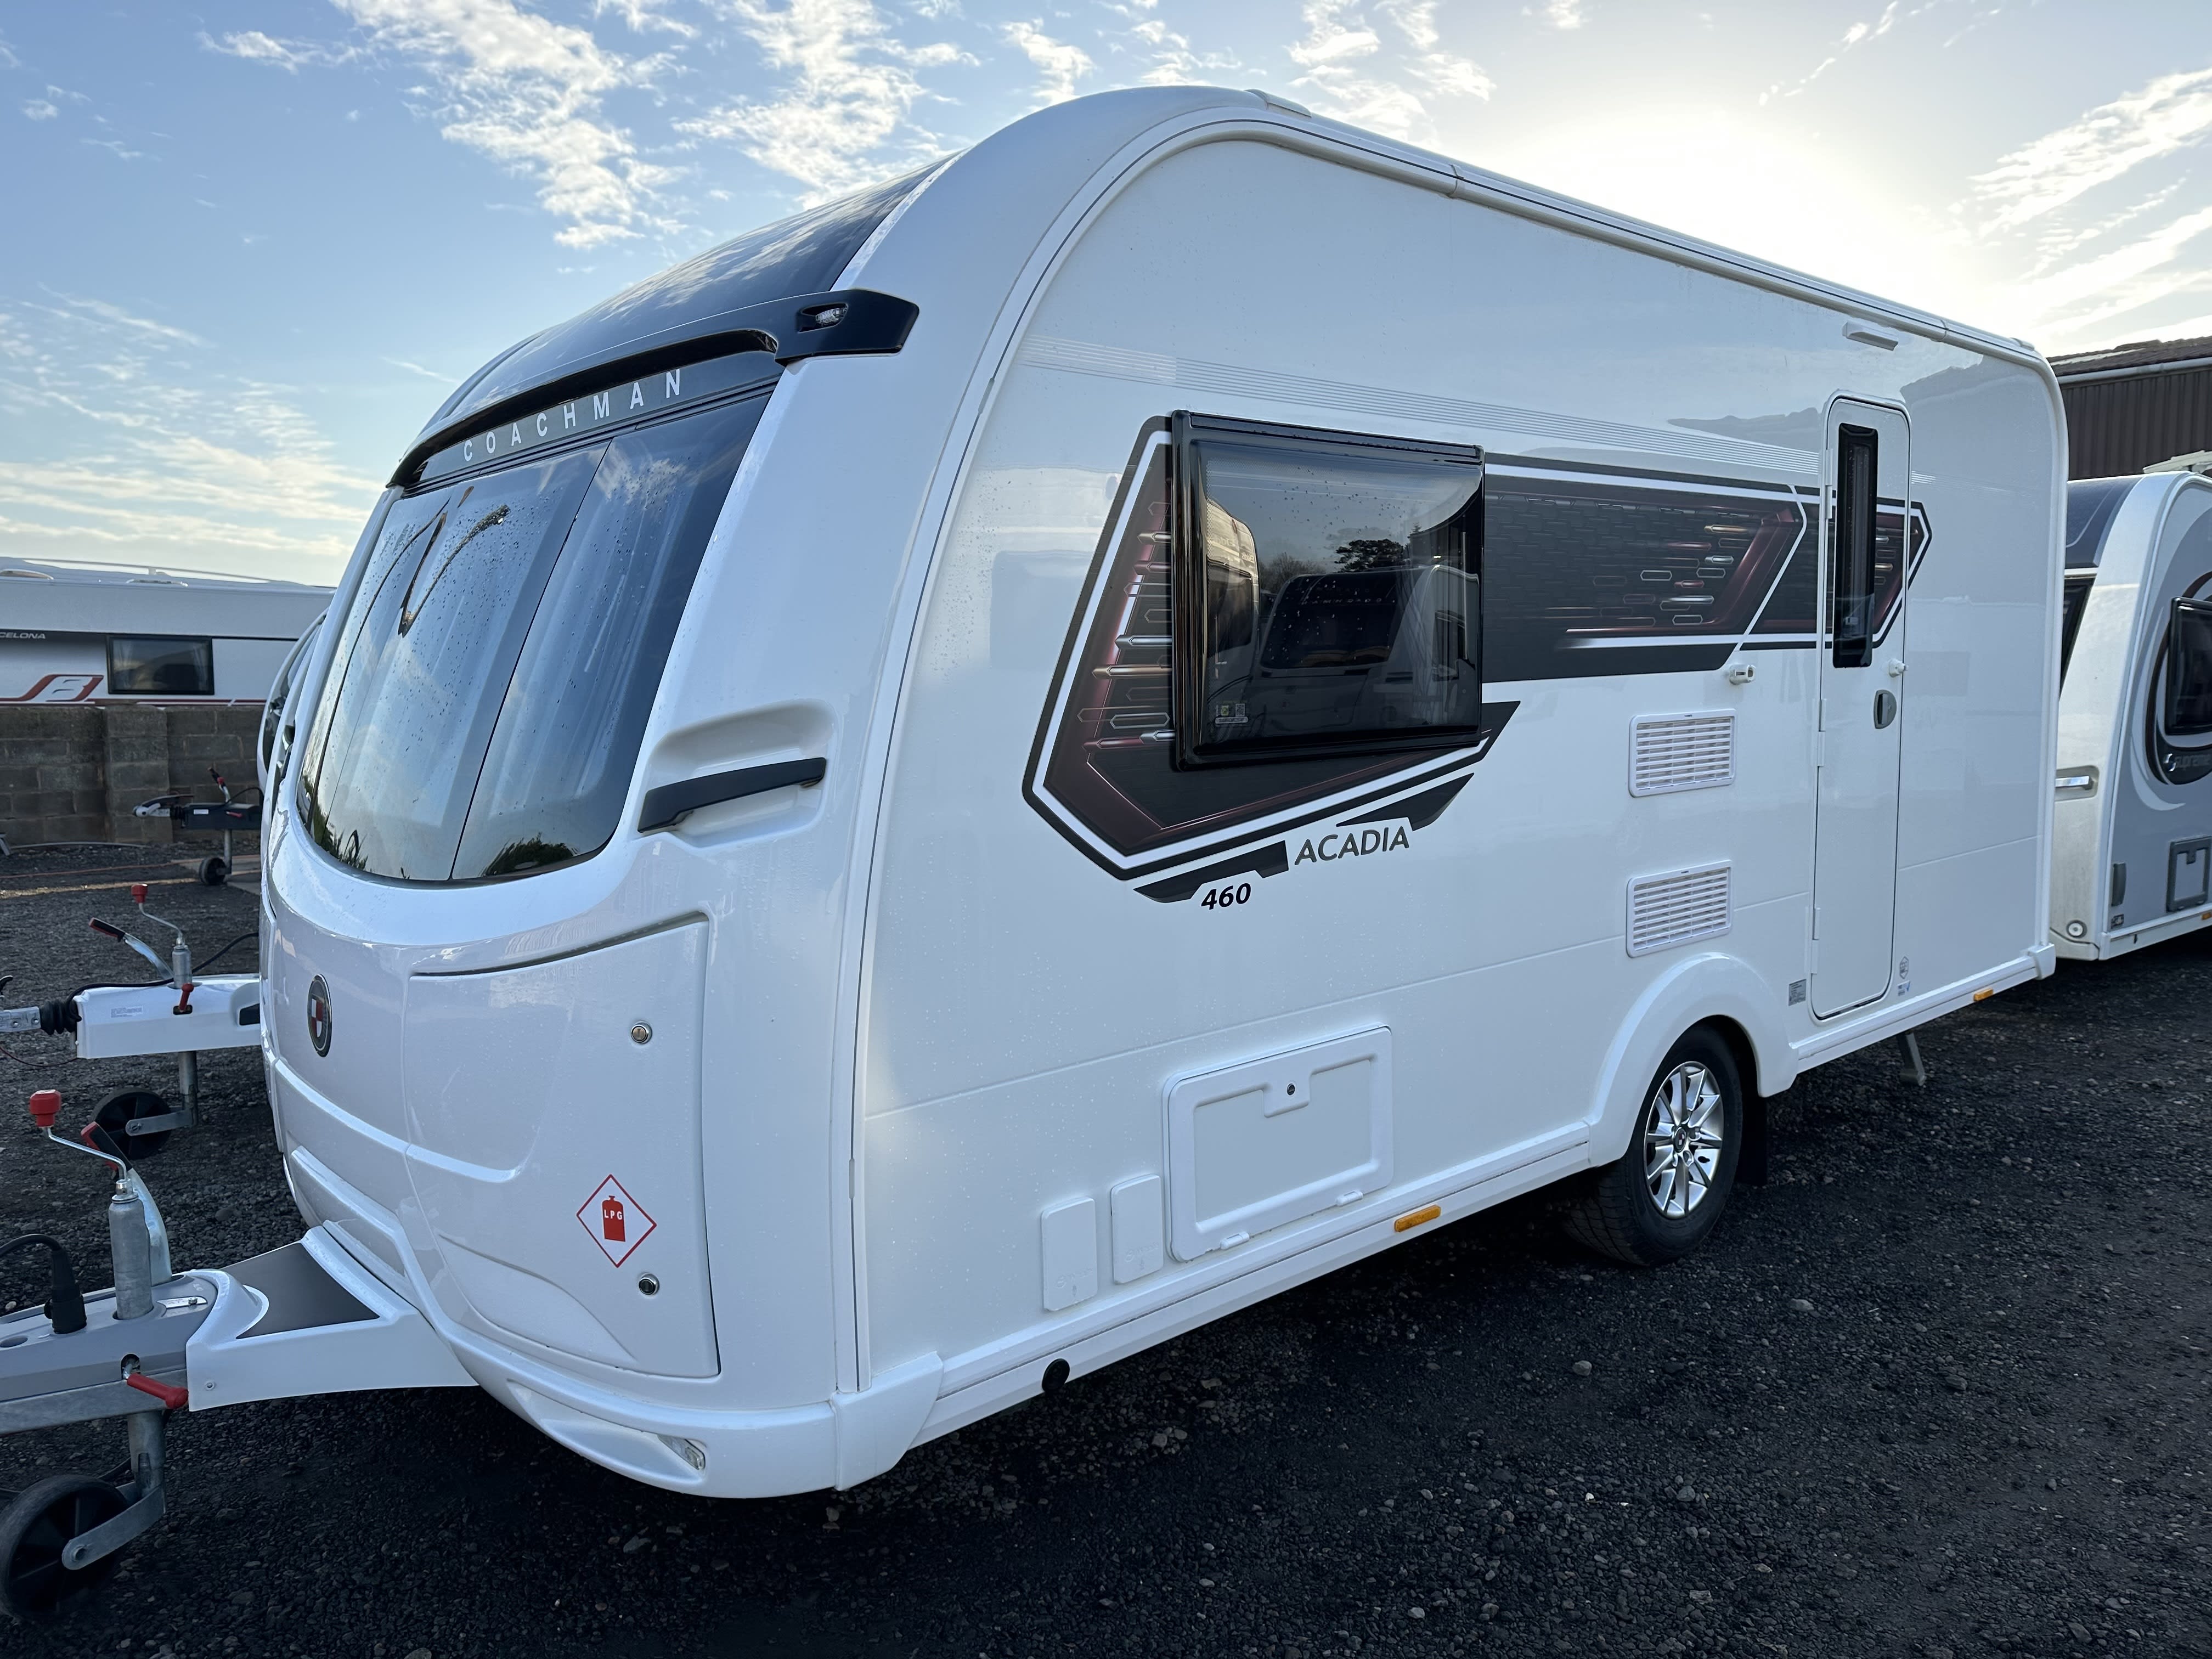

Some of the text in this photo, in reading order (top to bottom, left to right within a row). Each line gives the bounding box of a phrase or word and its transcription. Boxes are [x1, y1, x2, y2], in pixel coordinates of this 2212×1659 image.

[464, 369, 680, 461] COACHMAN
[1294, 826, 1409, 865] ACADIA
[1201, 883, 1251, 910] 460
[604, 1209, 623, 1221] LPG
